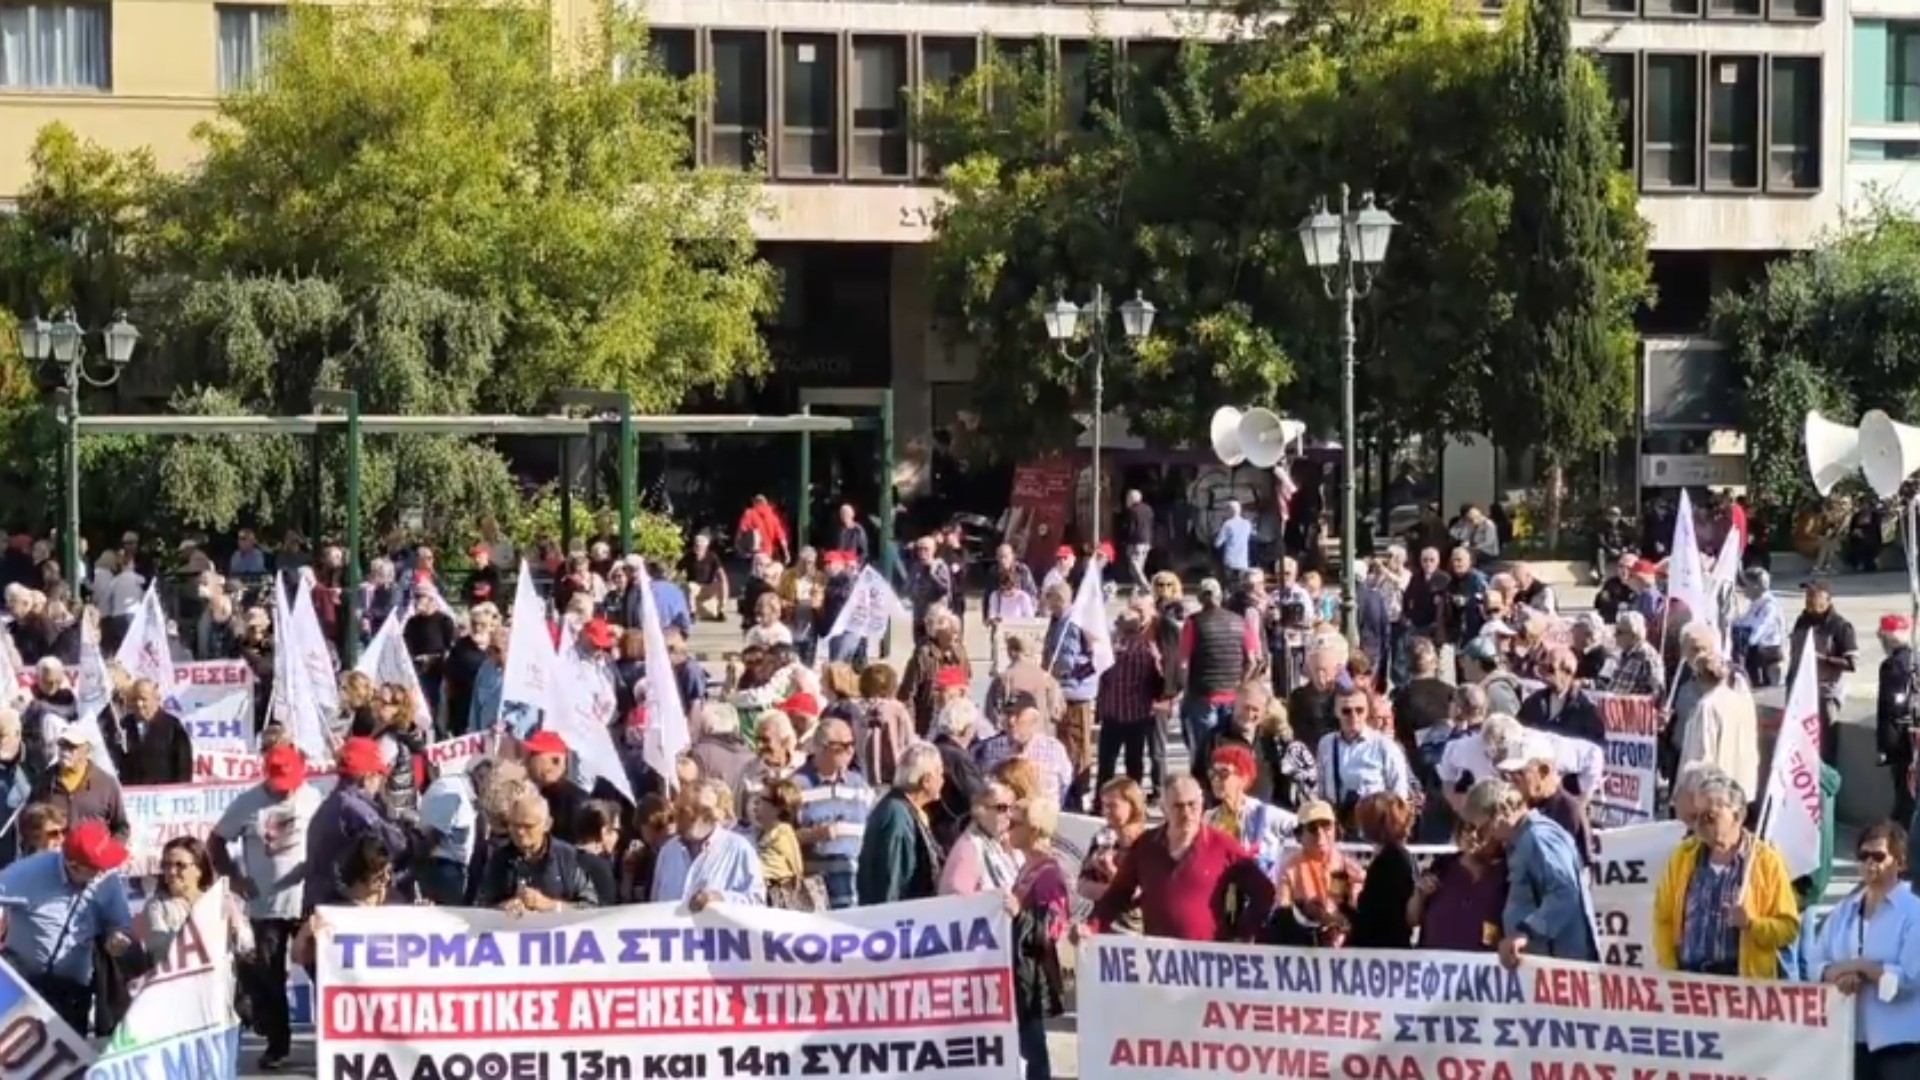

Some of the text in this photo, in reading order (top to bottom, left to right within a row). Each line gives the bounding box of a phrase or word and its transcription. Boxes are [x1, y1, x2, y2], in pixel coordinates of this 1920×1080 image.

[333, 917, 998, 968] ΤΕΡΜΑ ΠΙΑ ΣΤΗΝ ΚΟΡΟΪΔΙΑ
[333, 974, 1003, 1033] ΟΥΣΙΑΣΤΙΚΕΣ ΑΥΞΗΣΕΙΣ ΣΤΙΣ ΣΥΝΤΑΞΕΙΣ
[1099, 947, 1828, 1028] ΜΕ ΧΑΝΤΡΕΣ ΚΑΙ ΚΑΘΡΕΦΤΑΚΙΑ ΔΕΝ ΜΑΣ ΞΕΓΕΛΑΤΕ!
[334, 1036, 1003, 1080] ΝΑ ΔΟΘΕΙ 13η και 14η ΣΥΝΤΑΞΗ
[1203, 1001, 1723, 1060] ΑΥΞΗΣΕΙΣ ΣΤΙΣ ΣΥΝΤΑΞΕΙΣ
[1110, 1038, 1330, 1079] ΑΠΑΙΤΟΥΜΕ
[1342, 1053, 1424, 1080] ΟΛΑ
[1437, 1056, 1514, 1080] ΟΣΑ
